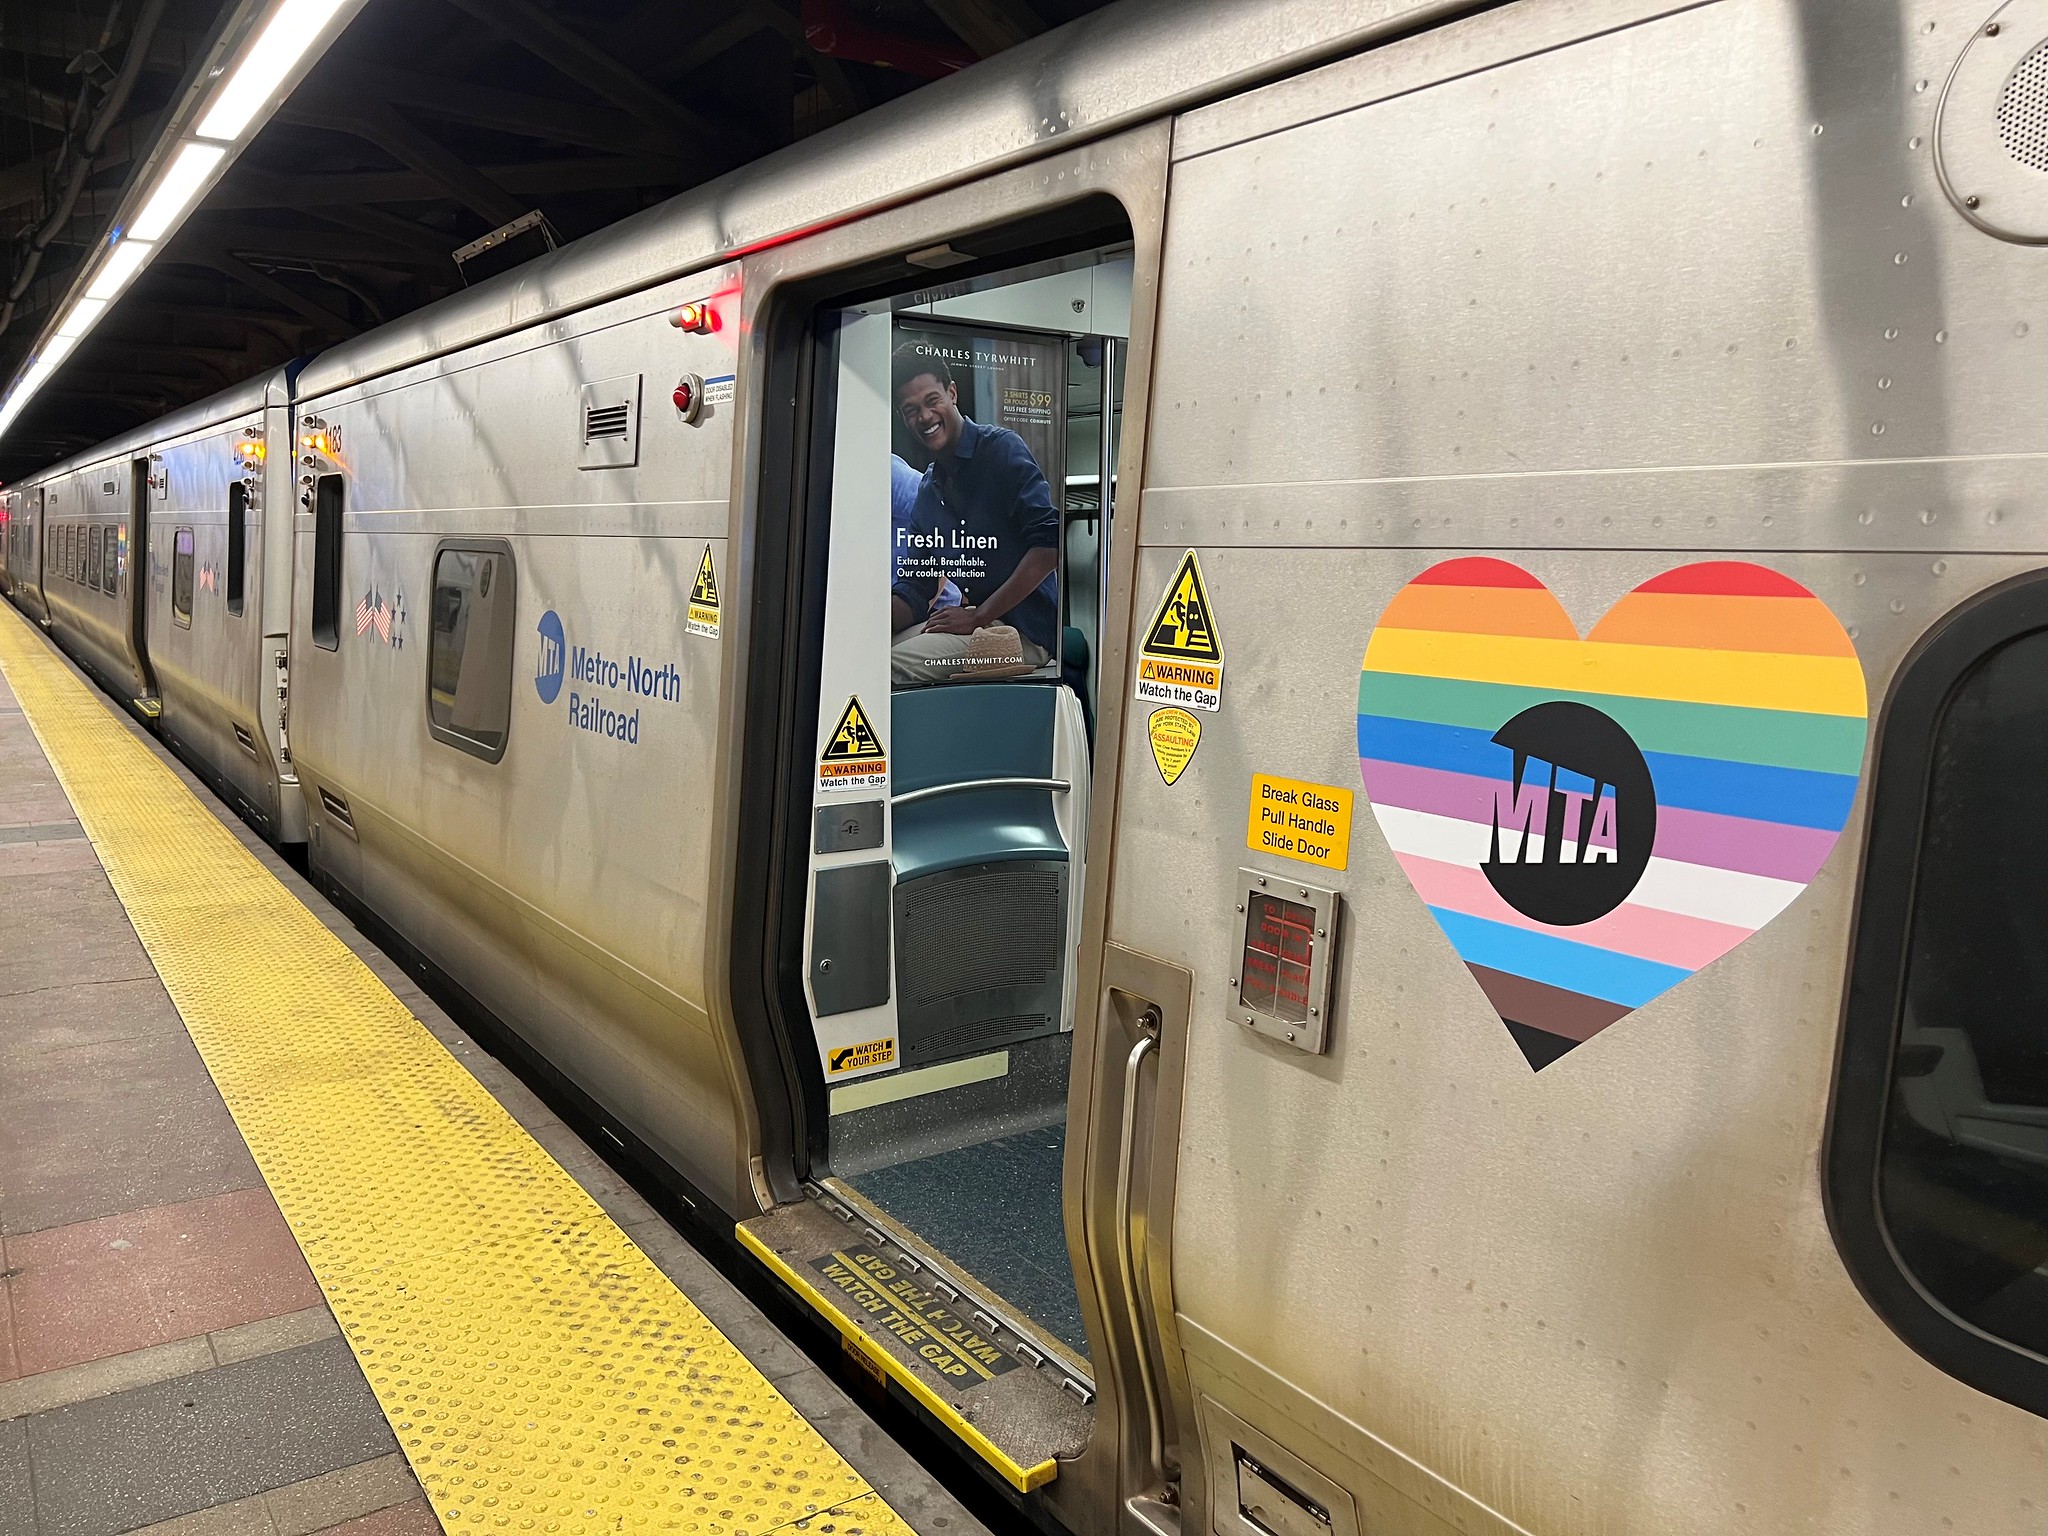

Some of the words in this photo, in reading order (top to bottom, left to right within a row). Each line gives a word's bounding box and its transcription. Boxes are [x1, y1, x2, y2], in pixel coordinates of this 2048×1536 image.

[915, 345, 970, 360] CHARLES
[975, 351, 1036, 367] TYRWHITT
[1004, 390, 1009, 398] 3
[1010, 391, 1029, 400] SHIRTS
[1030, 392, 1052, 408] $99
[1028, 407, 1051, 415] SHIPPING
[896, 526, 945, 548] Fresh
[952, 529, 998, 549] Linen
[897, 556, 919, 566] Extra
[920, 556, 939, 567] soft.
[940, 556, 987, 567] Breathable.
[896, 567, 914, 578] Our
[915, 567, 946, 578] coolest
[946, 567, 986, 578] collection
[694, 610, 718, 624] WARNING
[709, 625, 719, 637] Gap
[536, 634, 561, 678] MTA
[924, 656, 1023, 667] CHARLESTYRWHITT.COM
[571, 645, 681, 703] Metro-North
[1156, 665, 1214, 686] WARNING
[1139, 681, 1172, 699] Watch
[1174, 687, 1192, 702] the
[1194, 690, 1217, 708] Gap
[568, 692, 639, 745] Railroad
[1164, 715, 1189, 725] PROTECTED
[1174, 721, 1187, 732] STATE
[1152, 732, 1195, 748] ASSAULTING
[833, 763, 882, 775] WARNING
[820, 777, 848, 787] Watch
[851, 776, 865, 785] the
[868, 775, 886, 785] Gap
[1261, 784, 1298, 804] Break
[1301, 792, 1340, 812] Glass
[1480, 740, 1618, 864] MTA
[1261, 807, 1285, 825] Pull
[1288, 813, 1335, 836] Handle
[1262, 830, 1294, 851] Slide
[1297, 838, 1330, 859] Door
[1263, 903, 1276, 915] TO
[856, 1042, 884, 1056] WATCH
[847, 1055, 870, 1068] YOUR
[872, 1050, 892, 1063] STEP
[855, 1253, 897, 1281] GAP
[888, 1279, 930, 1311] THE
[821, 1263, 888, 1313] WATCH
[880, 1311, 926, 1345] THE
[919, 1344, 968, 1377] GAP
[928, 1309, 1003, 1365] WATCH
